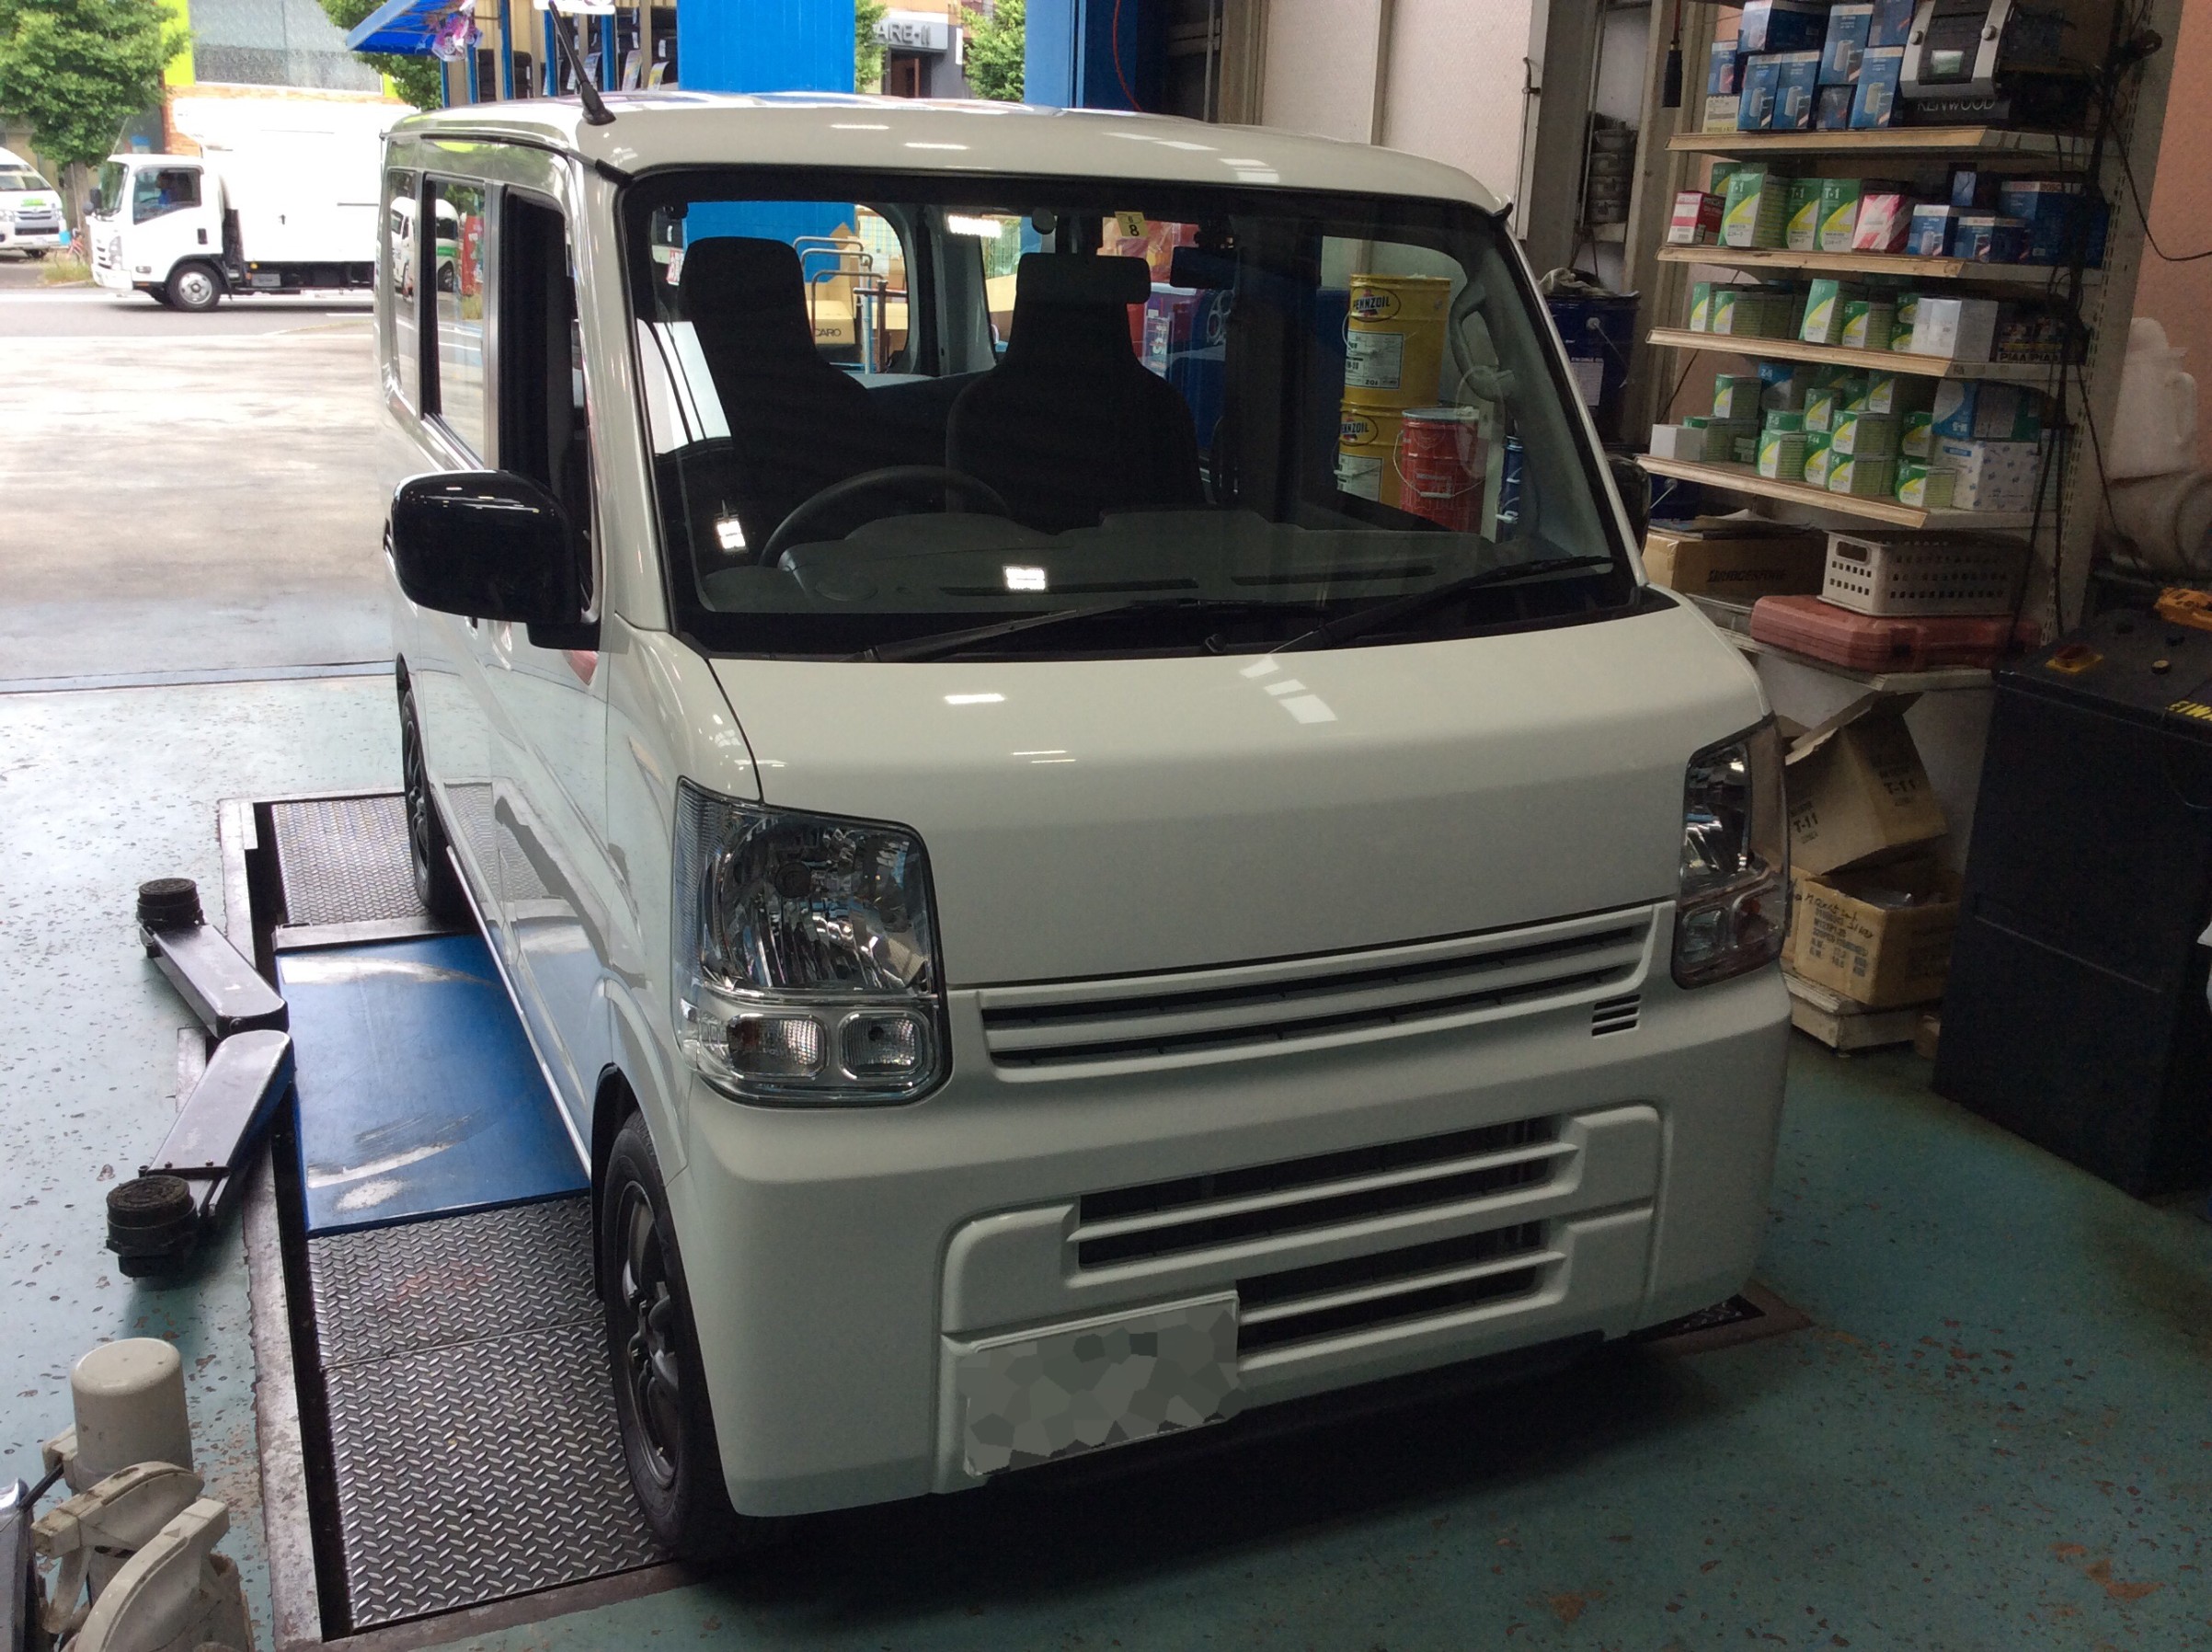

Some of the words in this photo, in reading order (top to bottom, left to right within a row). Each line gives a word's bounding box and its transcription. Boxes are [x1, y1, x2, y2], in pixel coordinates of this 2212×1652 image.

[1791, 186, 1805, 199] T-1
[1825, 186, 1840, 199] T-1
[1129, 224, 1140, 236] 8
[1353, 295, 1391, 310] PENNZOIL
[1884, 779, 1917, 795] T-11
[1793, 812, 1818, 832] T-11
